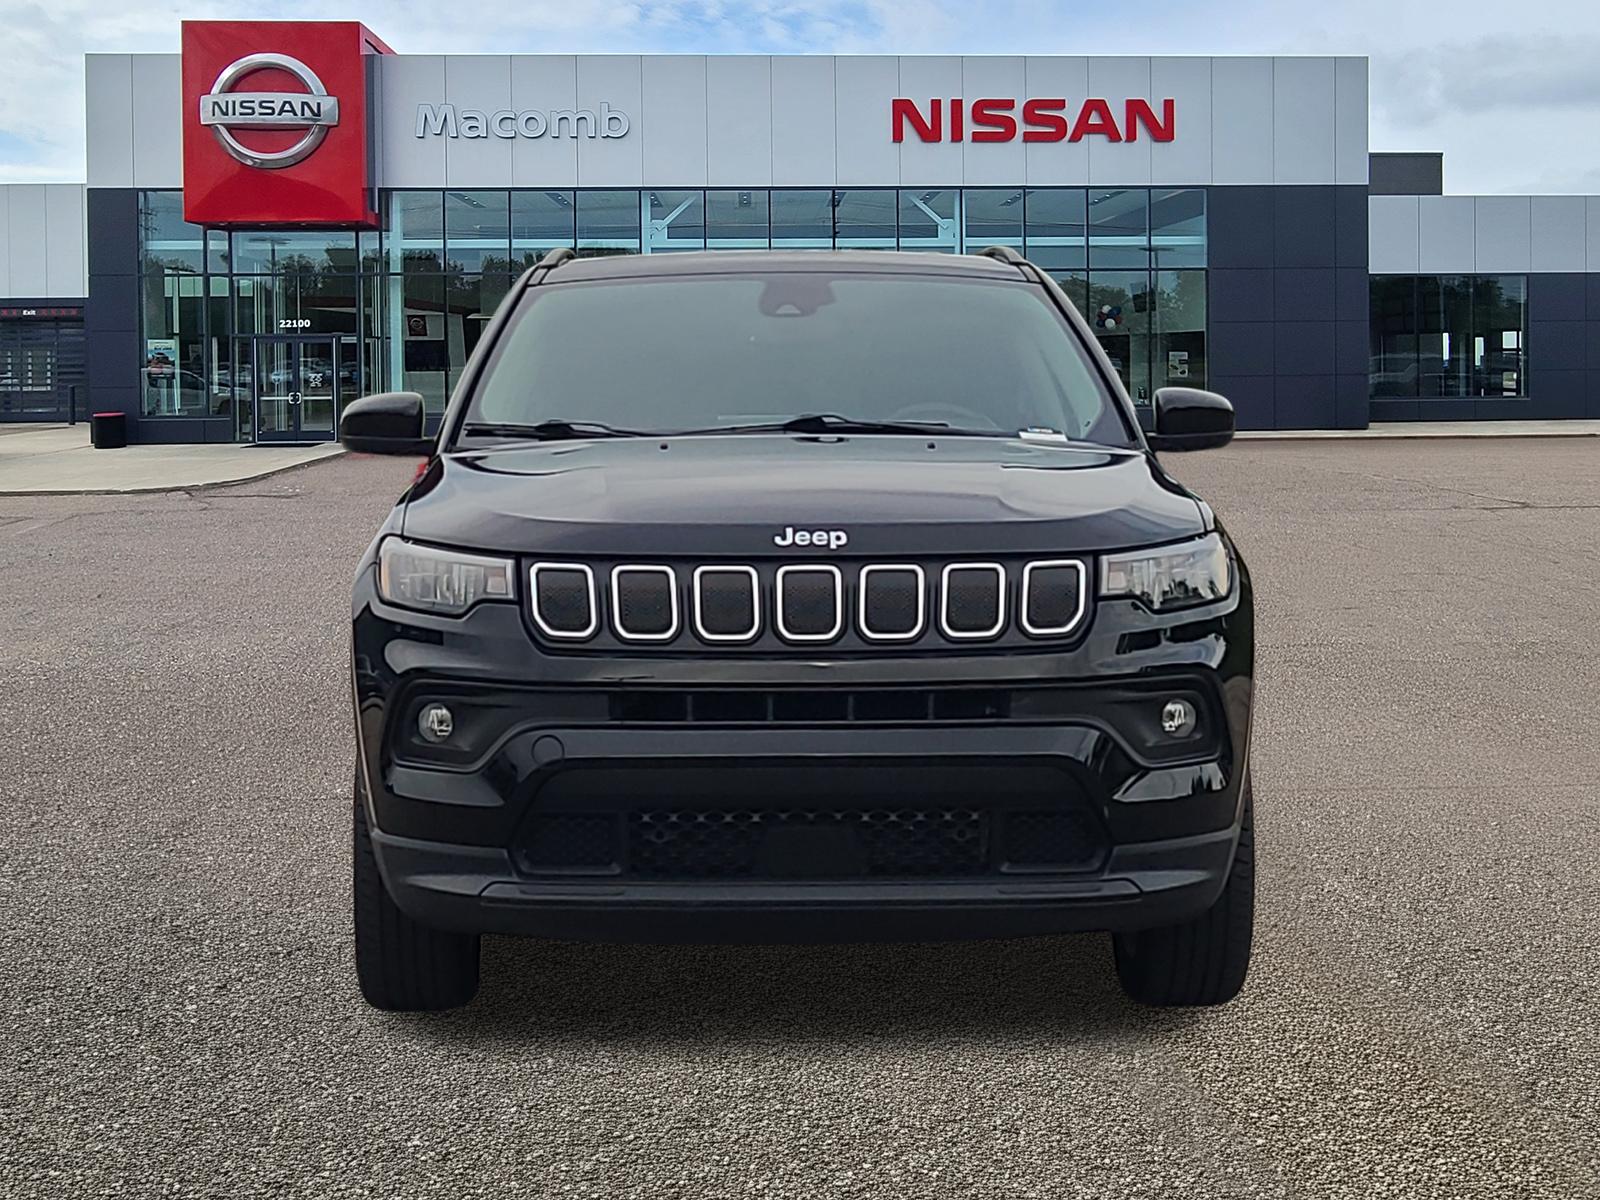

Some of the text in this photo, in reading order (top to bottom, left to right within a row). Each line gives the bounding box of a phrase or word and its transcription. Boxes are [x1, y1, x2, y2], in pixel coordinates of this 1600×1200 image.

[211, 100, 322, 118] NISSAN
[415, 102, 630, 139] Macomb
[891, 98, 1176, 143] NISSAN
[279, 319, 311, 328] 22100
[774, 526, 848, 550] Jeep
